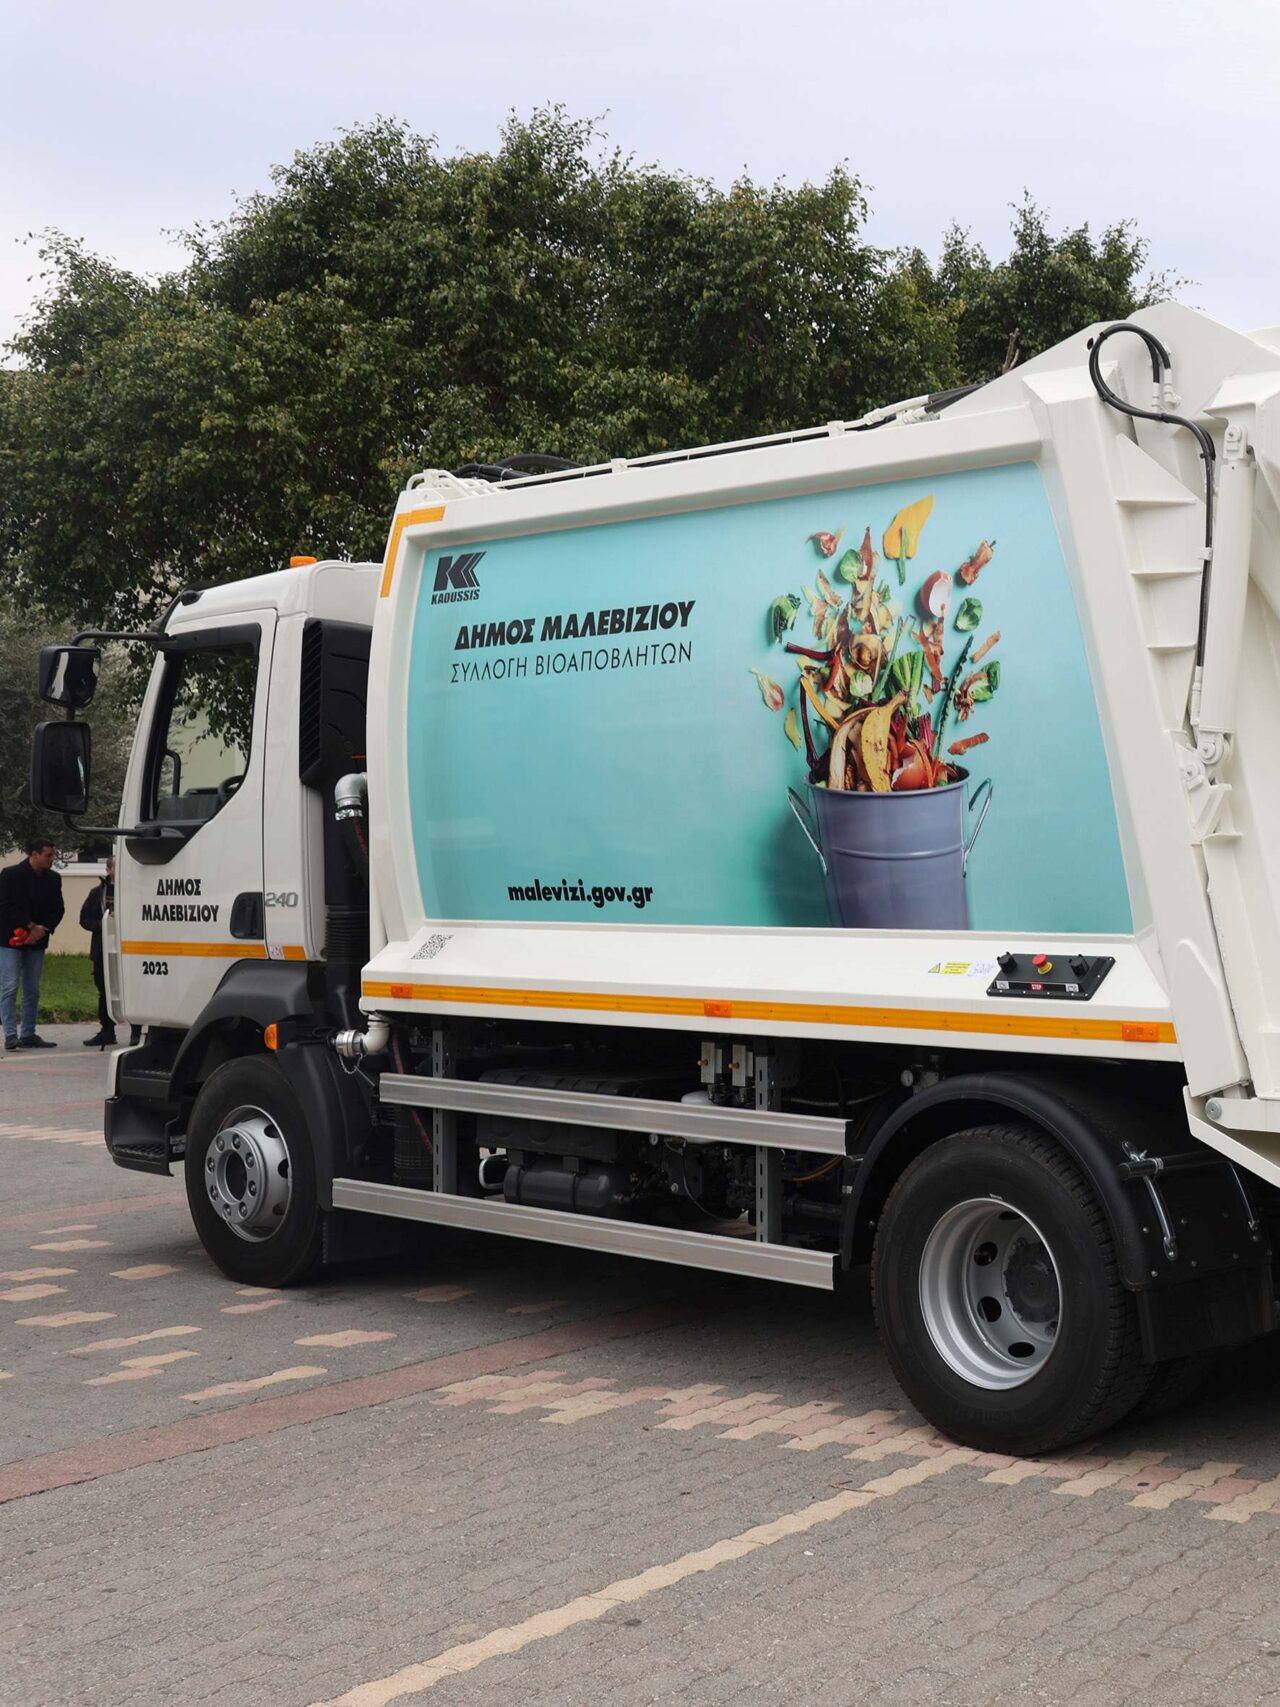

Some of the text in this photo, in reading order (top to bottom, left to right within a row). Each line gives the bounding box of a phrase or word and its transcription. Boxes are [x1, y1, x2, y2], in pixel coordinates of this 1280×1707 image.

[431, 588, 480, 605] KAOUSSIS
[454, 600, 696, 651] ΔΗΜΟΣ ΜΑΛΕΒΙΖΙΟΥ
[451, 641, 692, 683] ΣΥΛΛΟΓΗ ΒΙΟΑΠΟΒΛΗΤΩΝ
[156, 878, 202, 897] ΔΗΜΟΣ
[507, 878, 654, 909] malevizi.gov.gr
[264, 892, 298, 908] 240
[141, 904, 219, 923] ΜΑΛΕΒΙΖΙΟΥ
[142, 960, 169, 976] 2023
